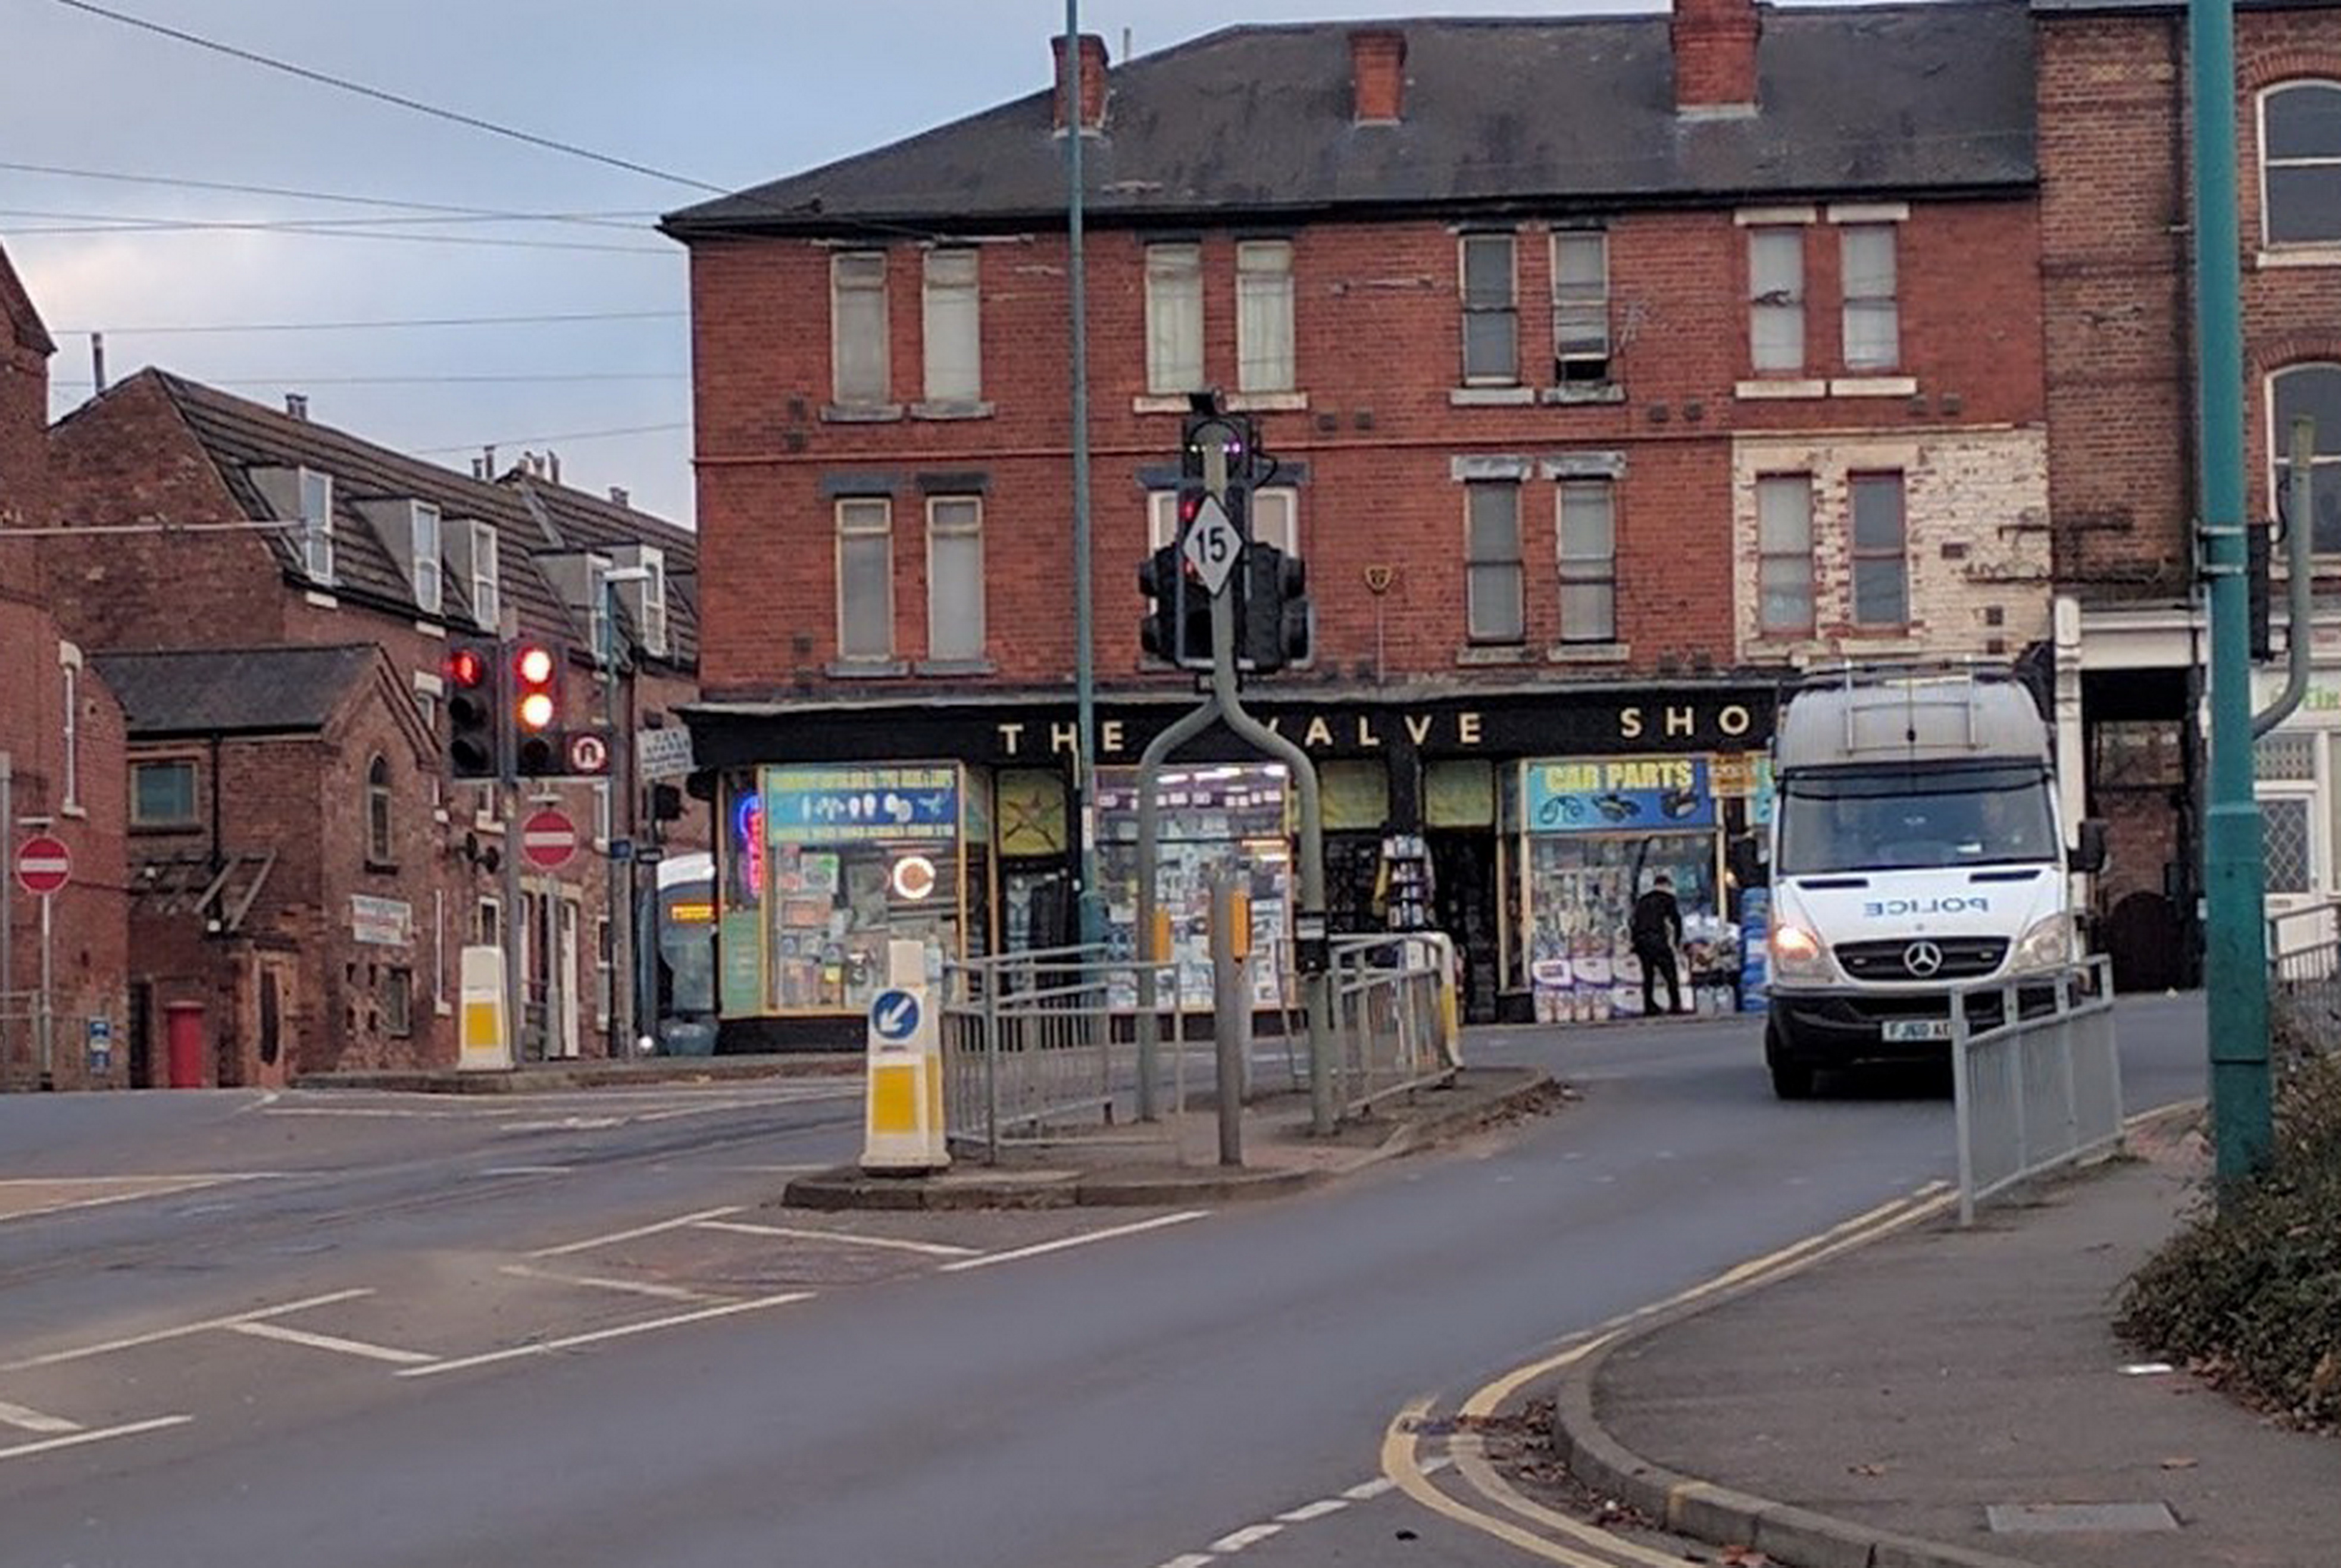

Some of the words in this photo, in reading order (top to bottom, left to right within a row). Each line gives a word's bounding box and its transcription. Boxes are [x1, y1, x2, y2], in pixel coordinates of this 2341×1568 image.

[1196, 527, 1227, 564] 15
[998, 720, 1124, 755] THE
[1620, 704, 1786, 737] SHO
[1546, 764, 1599, 790] CAR
[1608, 761, 1693, 788] PARTS
